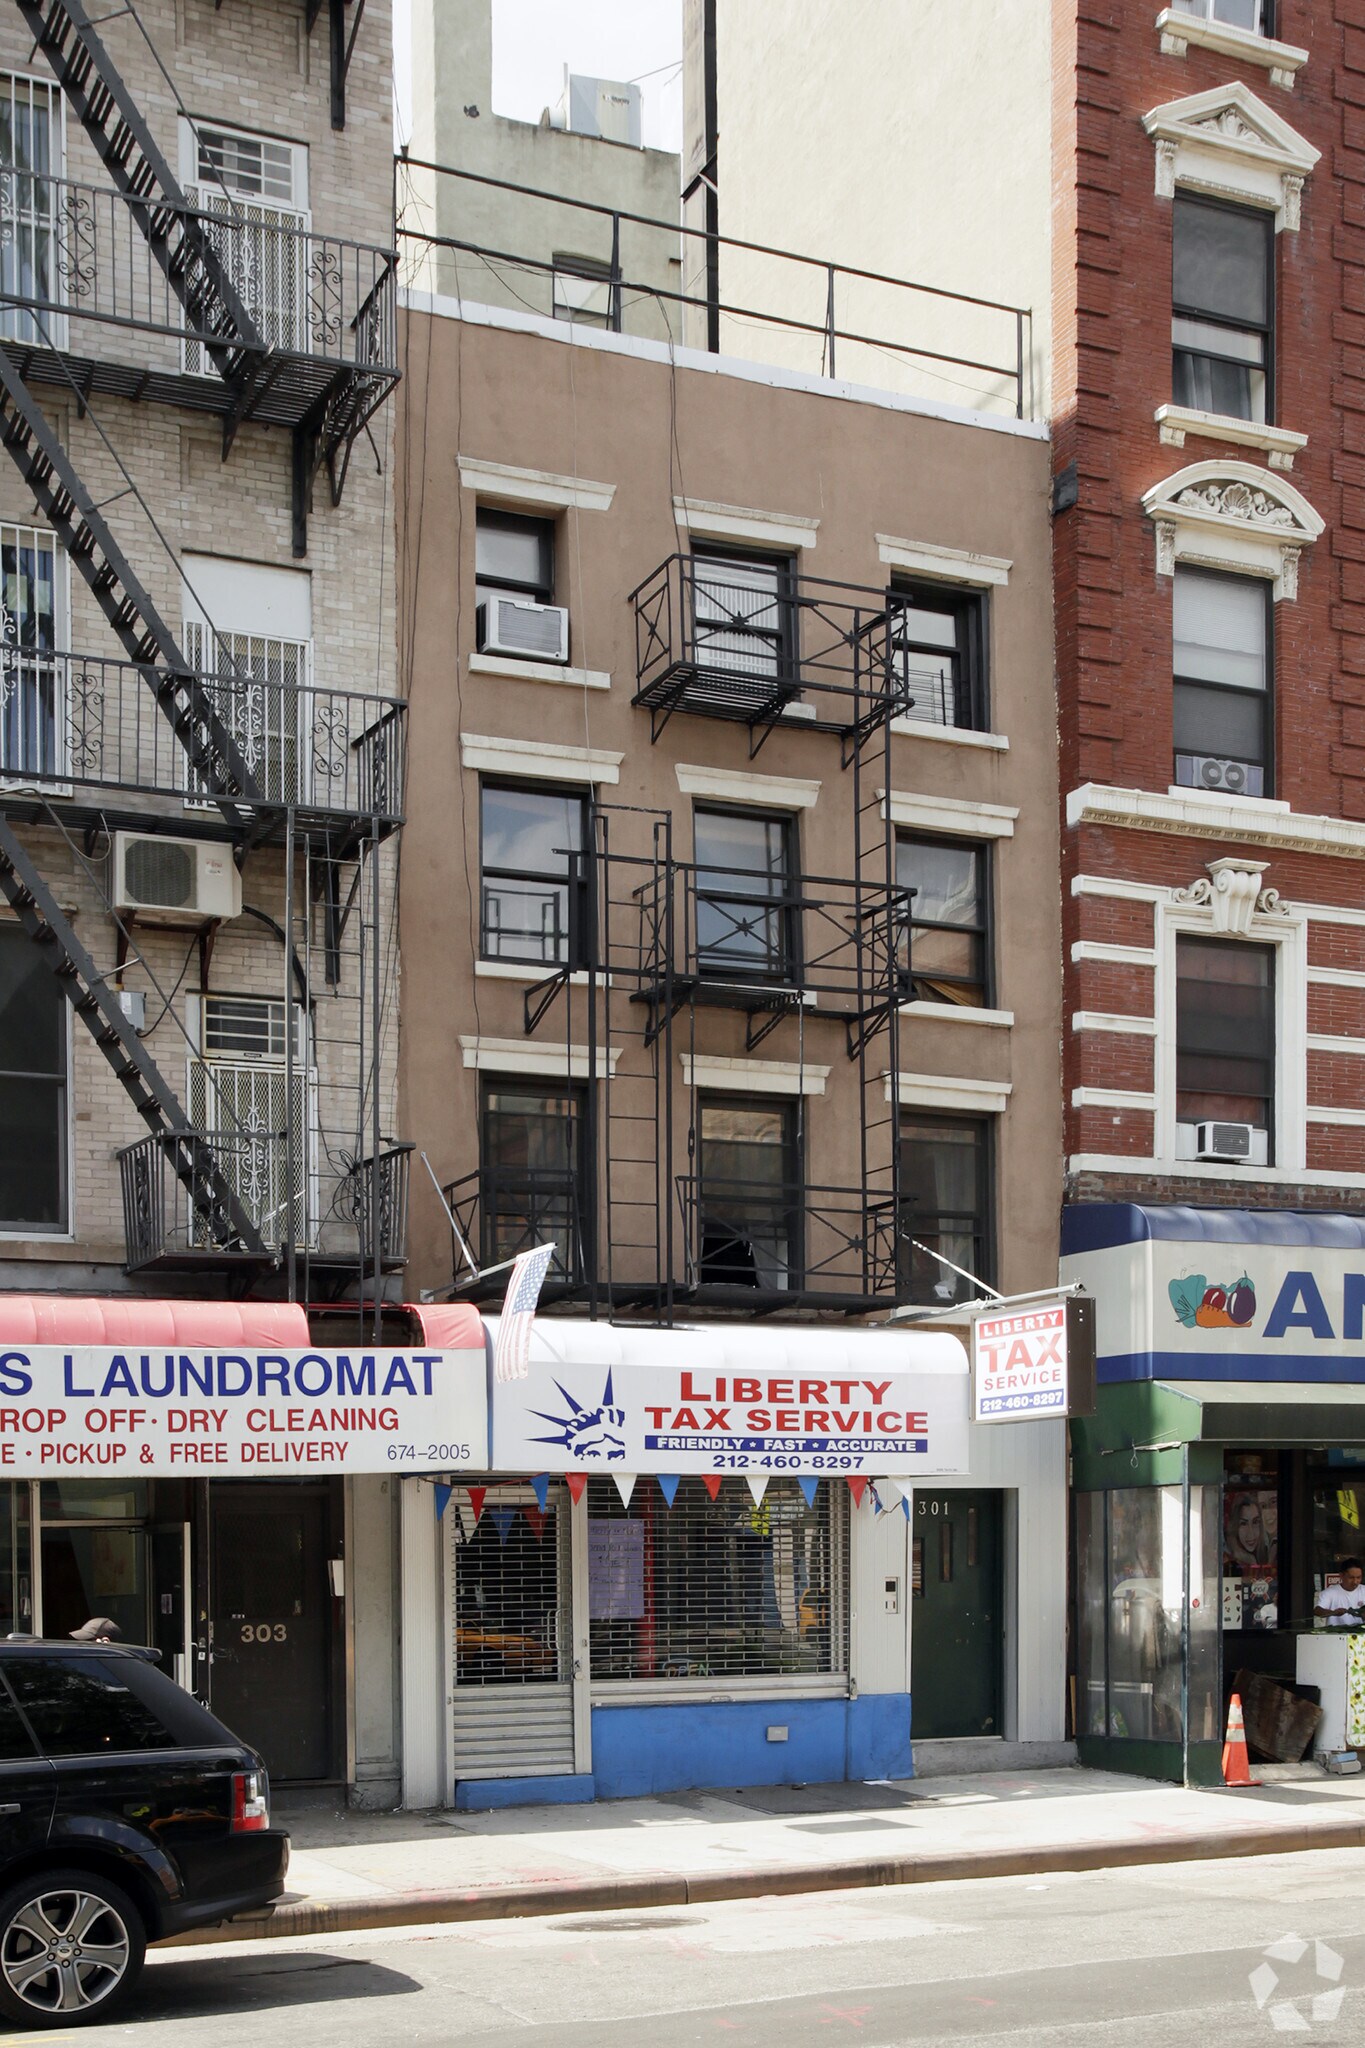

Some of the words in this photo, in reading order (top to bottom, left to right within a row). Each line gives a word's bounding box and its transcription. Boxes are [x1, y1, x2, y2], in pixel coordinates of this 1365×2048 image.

[983, 1312, 1059, 1337] LIBERTY
[980, 1332, 1063, 1373] TAX
[0, 1352, 33, 1396] S
[64, 1355, 443, 1397] LAUNDROMAT
[984, 1369, 1062, 1391] SERVICE
[680, 1372, 893, 1405] LIBERTY
[168, 1409, 229, 1433] DRY
[246, 1407, 399, 1433] CLEANING
[644, 1407, 732, 1430] TAX
[746, 1409, 929, 1433] SERVICE
[40, 1443, 127, 1464] PICKUP
[139, 1444, 155, 1464] &
[170, 1443, 229, 1463] FREE
[241, 1441, 349, 1463] DELIVERY
[387, 1444, 471, 1461] 674-2005
[656, 1437, 745, 1450] FRIENDLY
[763, 1439, 807, 1451] FAST
[825, 1440, 917, 1452] ACCURATE
[712, 1454, 865, 1469] 212-460-8297
[918, 1501, 949, 1516] 301
[240, 1624, 288, 1643] 303
